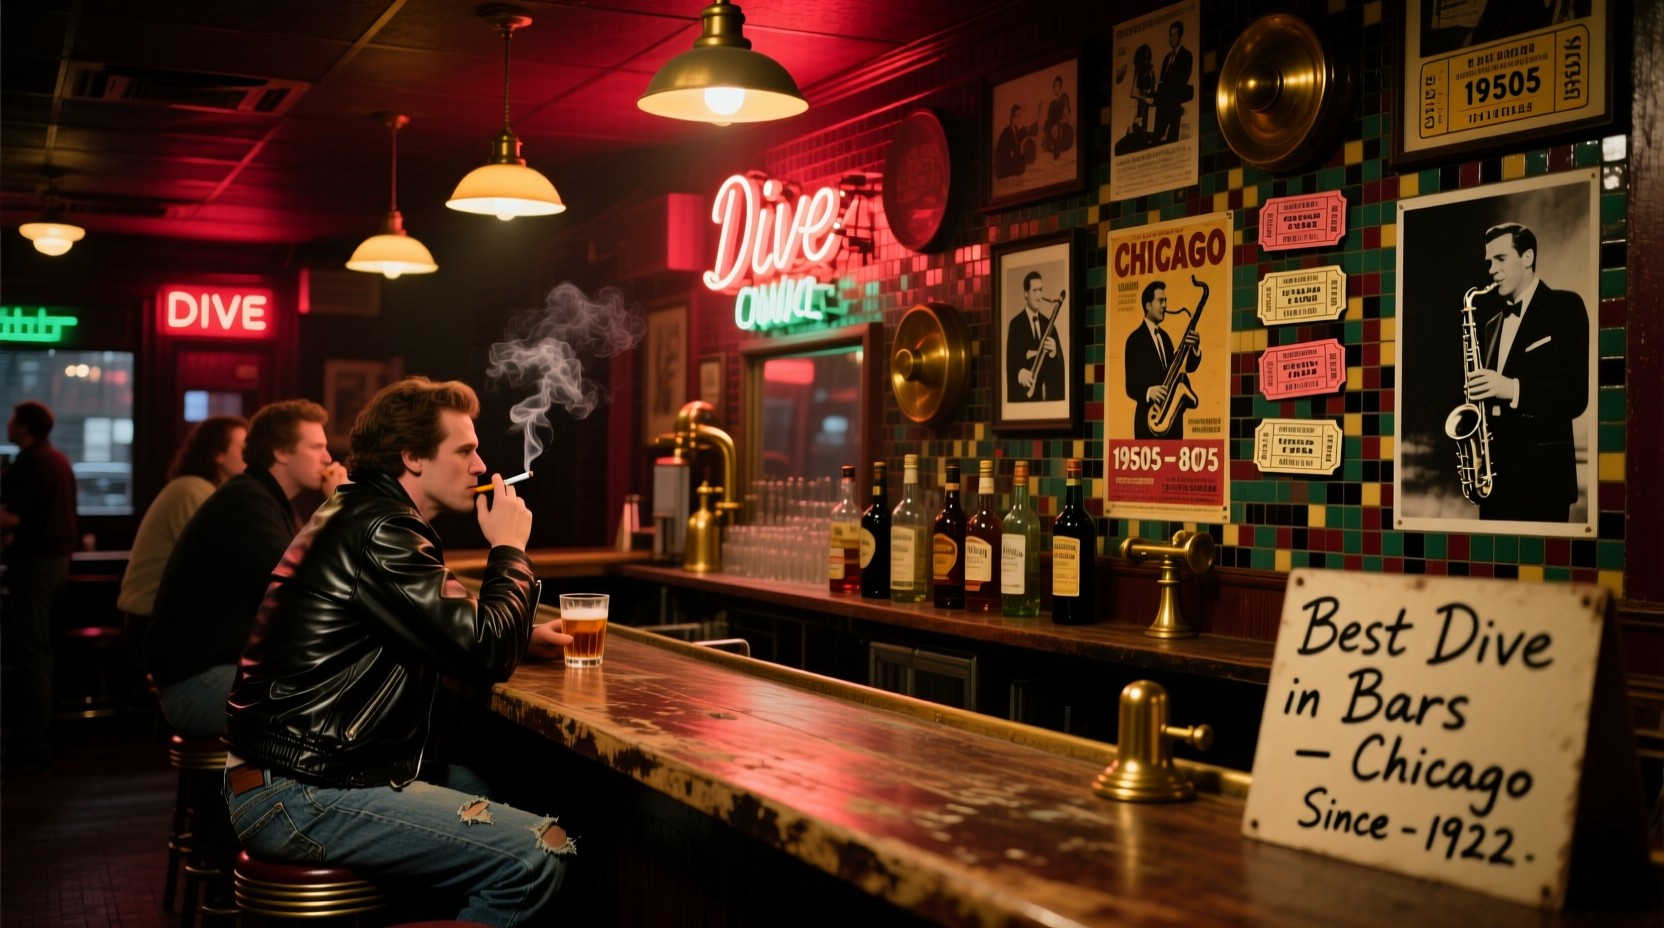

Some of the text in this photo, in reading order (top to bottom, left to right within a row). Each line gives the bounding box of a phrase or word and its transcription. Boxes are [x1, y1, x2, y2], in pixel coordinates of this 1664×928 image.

[703, 174, 840, 290] Dive
[1114, 228, 1226, 278] CHICAGO
[167, 291, 268, 331] DIVE
[1297, 596, 1554, 670] Best Dive
[1284, 668, 1470, 730] in Bars
[1352, 733, 1533, 818] Chicago
[1297, 787, 1389, 839] Since
